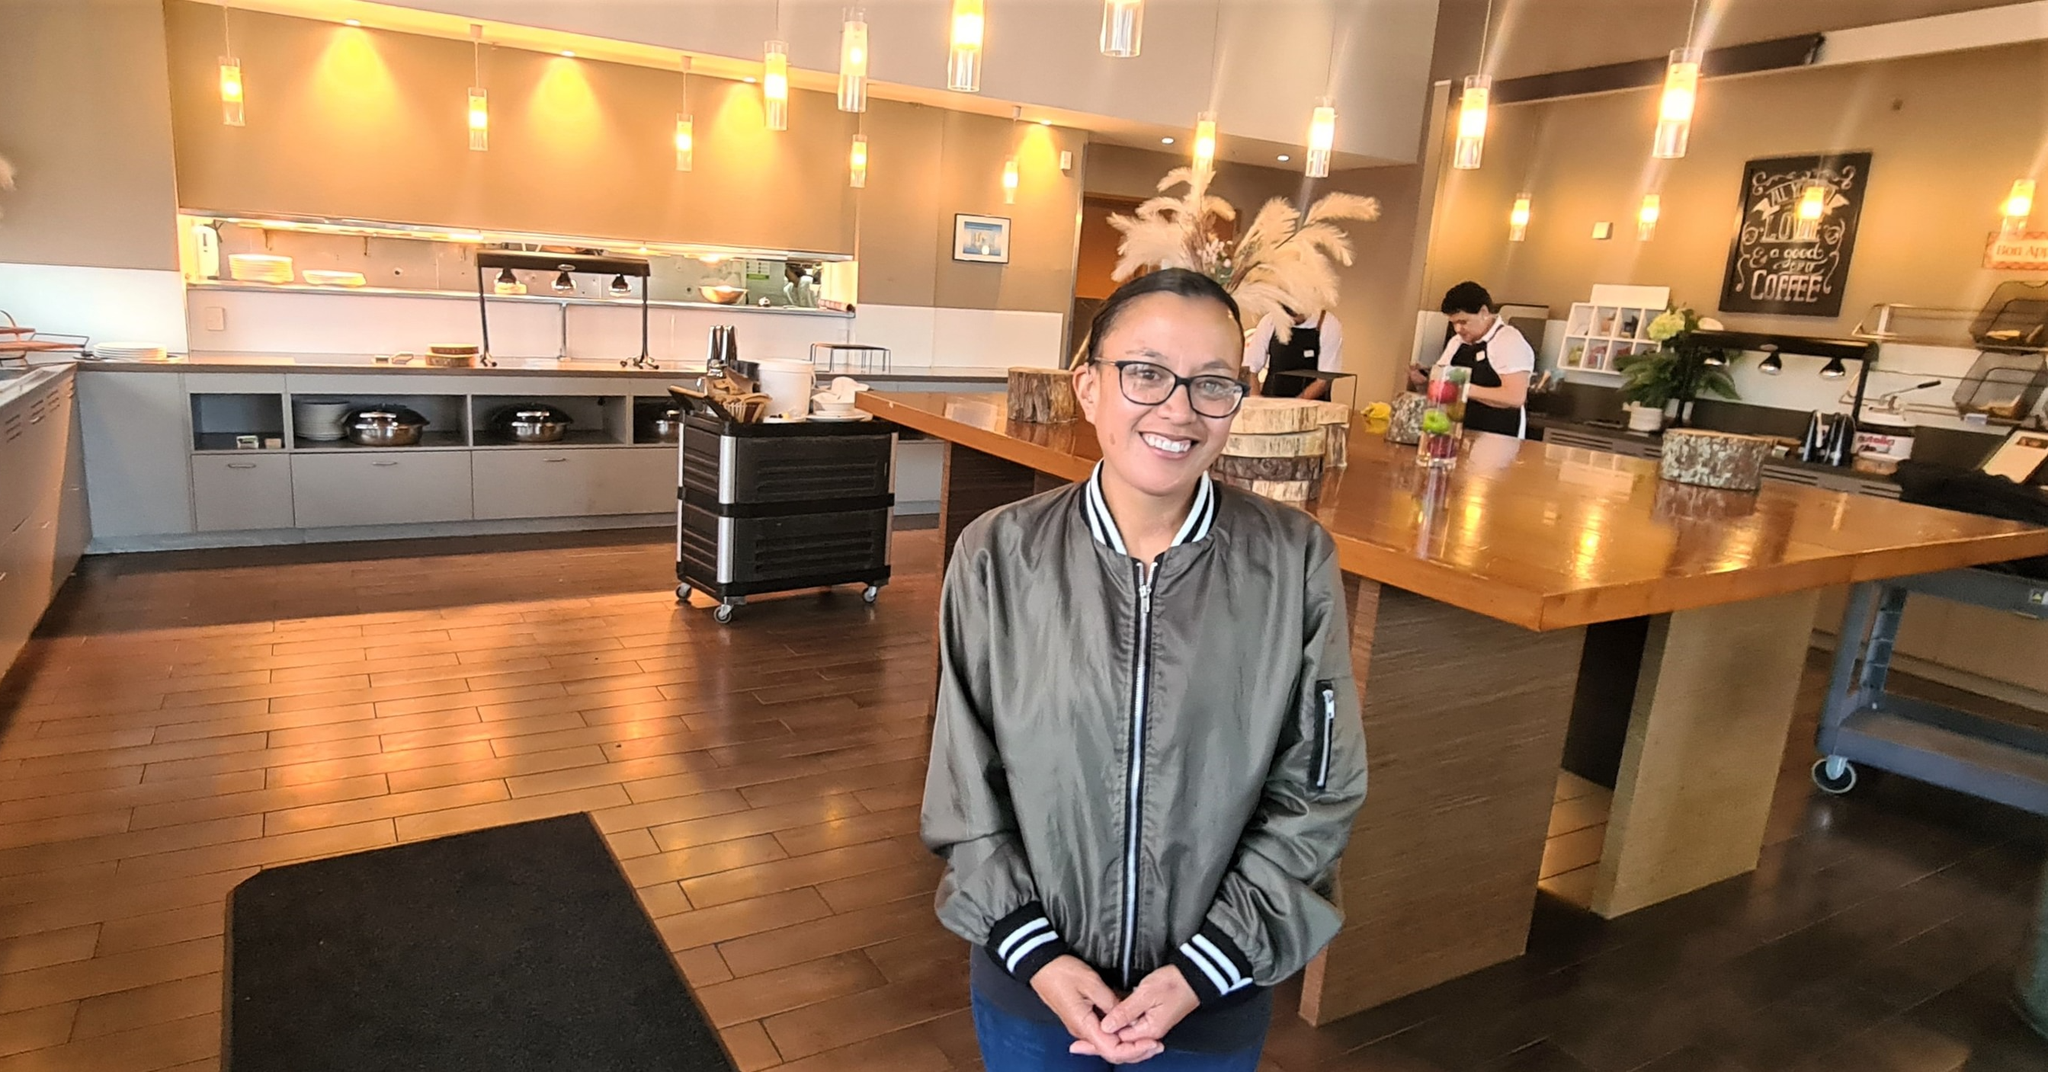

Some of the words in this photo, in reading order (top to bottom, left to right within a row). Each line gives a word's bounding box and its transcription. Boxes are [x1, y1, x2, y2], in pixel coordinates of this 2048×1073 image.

[1769, 248, 1780, 259] a
[1783, 243, 1825, 267] good
[1751, 269, 1823, 302] COFFEE
